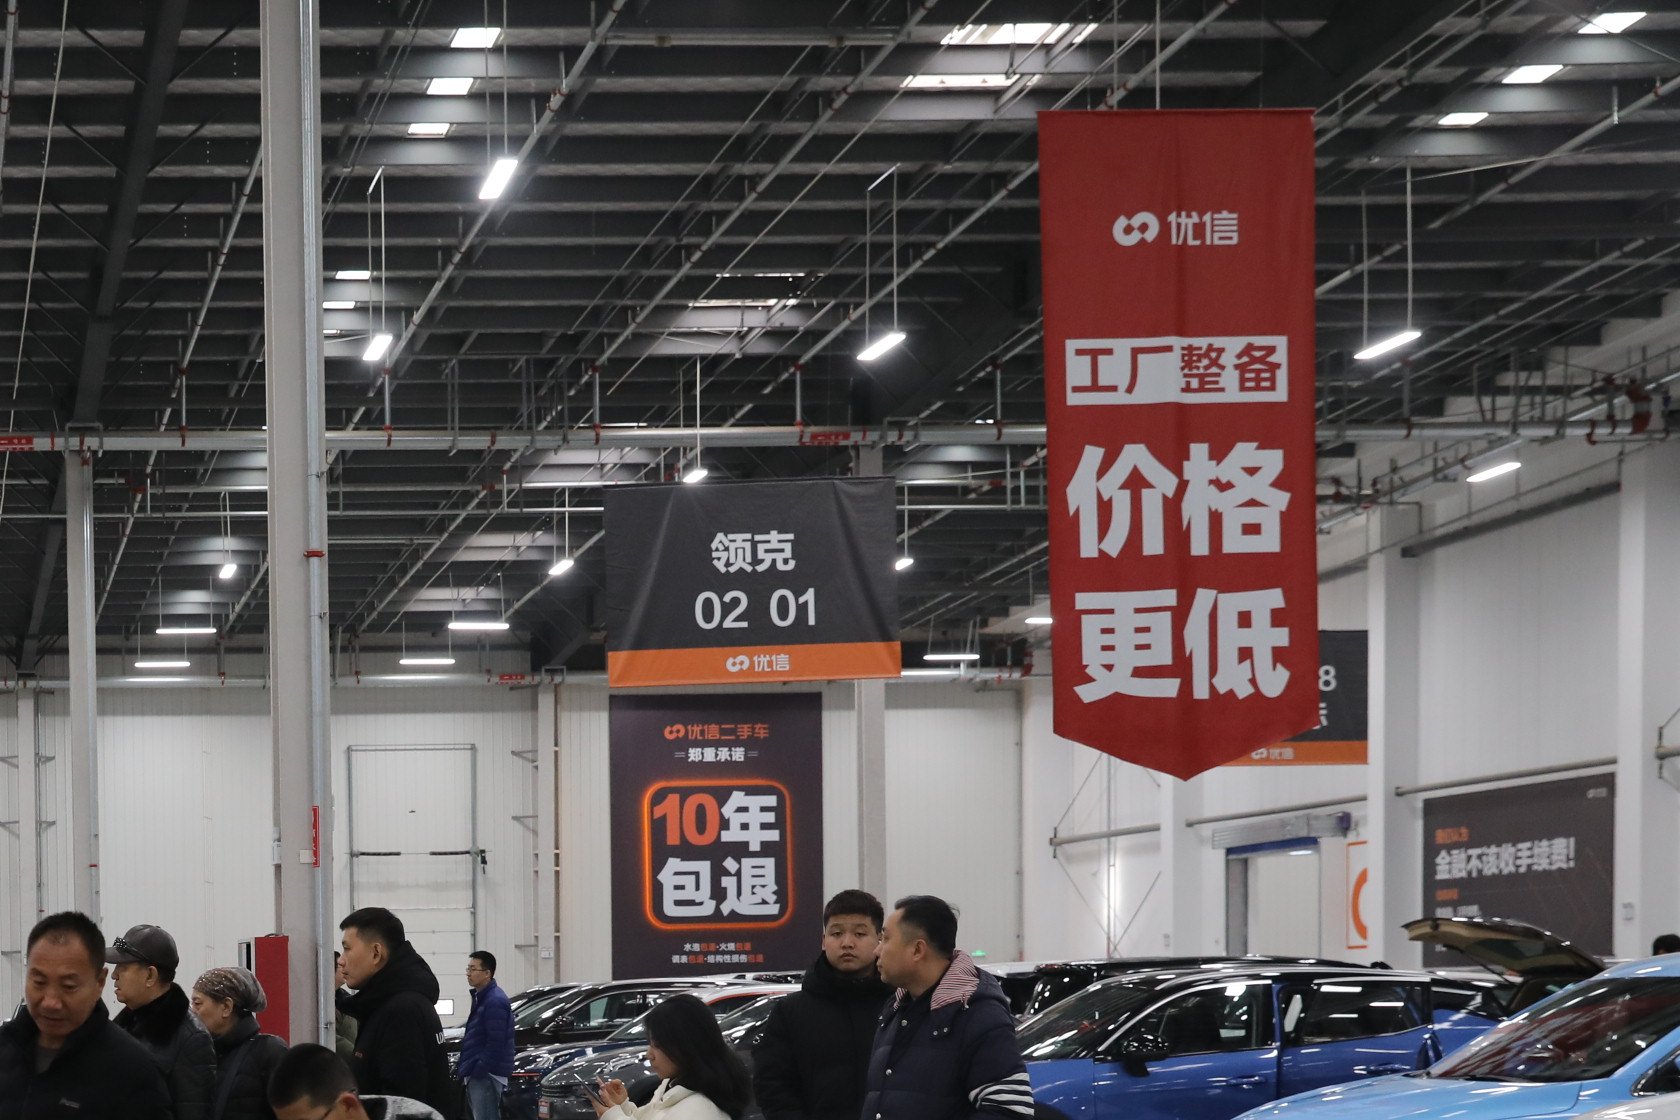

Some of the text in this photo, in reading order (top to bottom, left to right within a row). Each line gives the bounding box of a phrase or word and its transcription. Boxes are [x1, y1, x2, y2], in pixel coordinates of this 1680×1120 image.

[1168, 210, 1239, 246] 优信
[1071, 341, 1282, 396] 工厂整备
[1066, 442, 1291, 559] 价格
[710, 530, 796, 574] 领克
[694, 587, 817, 630] 02 01
[753, 653, 790, 672] 优信
[1073, 587, 1290, 704] 更低
[687, 724, 769, 740] 优信二手车
[687, 746, 745, 762] 郑重承诺
[652, 790, 780, 852] 10年
[656, 856, 780, 917] 包退
